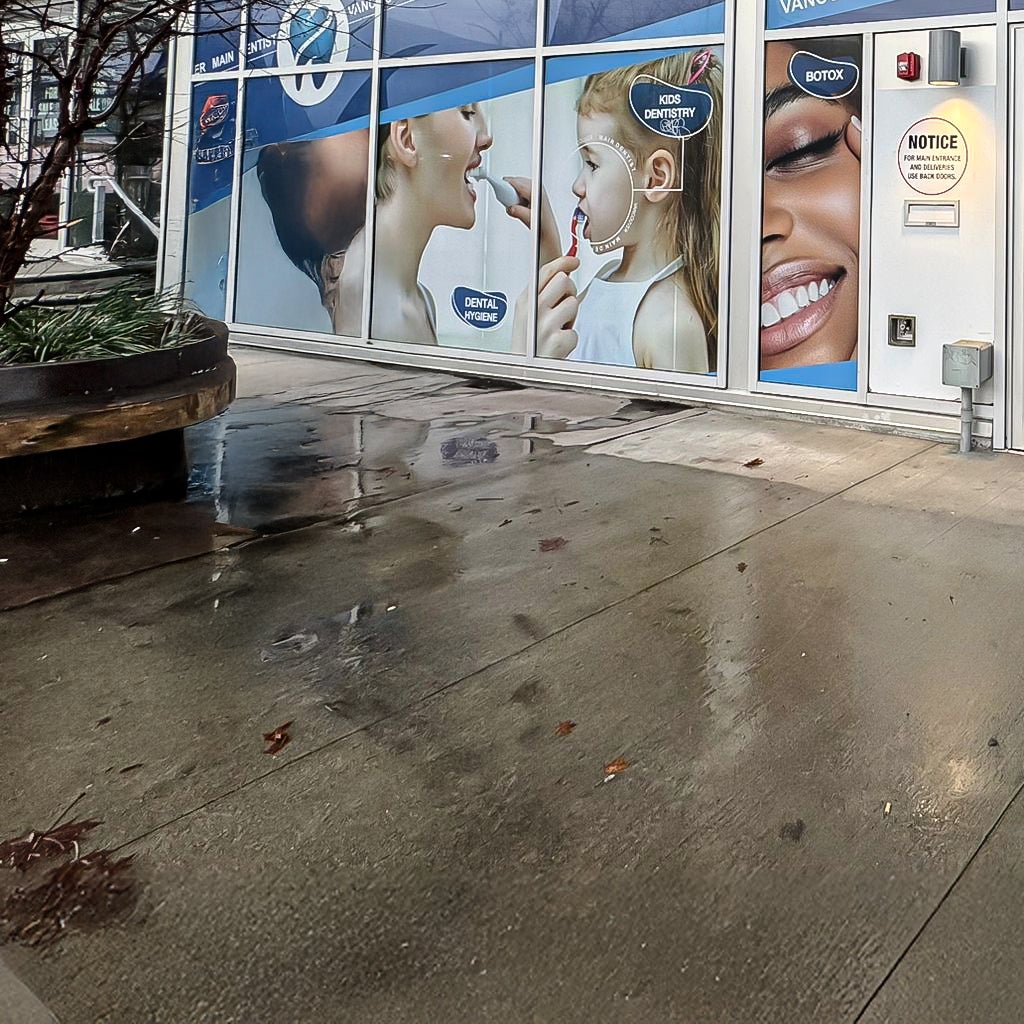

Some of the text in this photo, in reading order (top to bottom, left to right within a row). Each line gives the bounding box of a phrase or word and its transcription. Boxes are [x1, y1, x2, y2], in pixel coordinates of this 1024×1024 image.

[212, 51, 235, 69] MAIN
[805, 68, 844, 83] BOTOX
[659, 94, 681, 105] KIDS
[644, 107, 696, 119] DENTISTRY
[908, 134, 958, 150] NOTICE
[464, 296, 499, 309] DENTAL
[464, 310, 498, 322] HYGIENE
